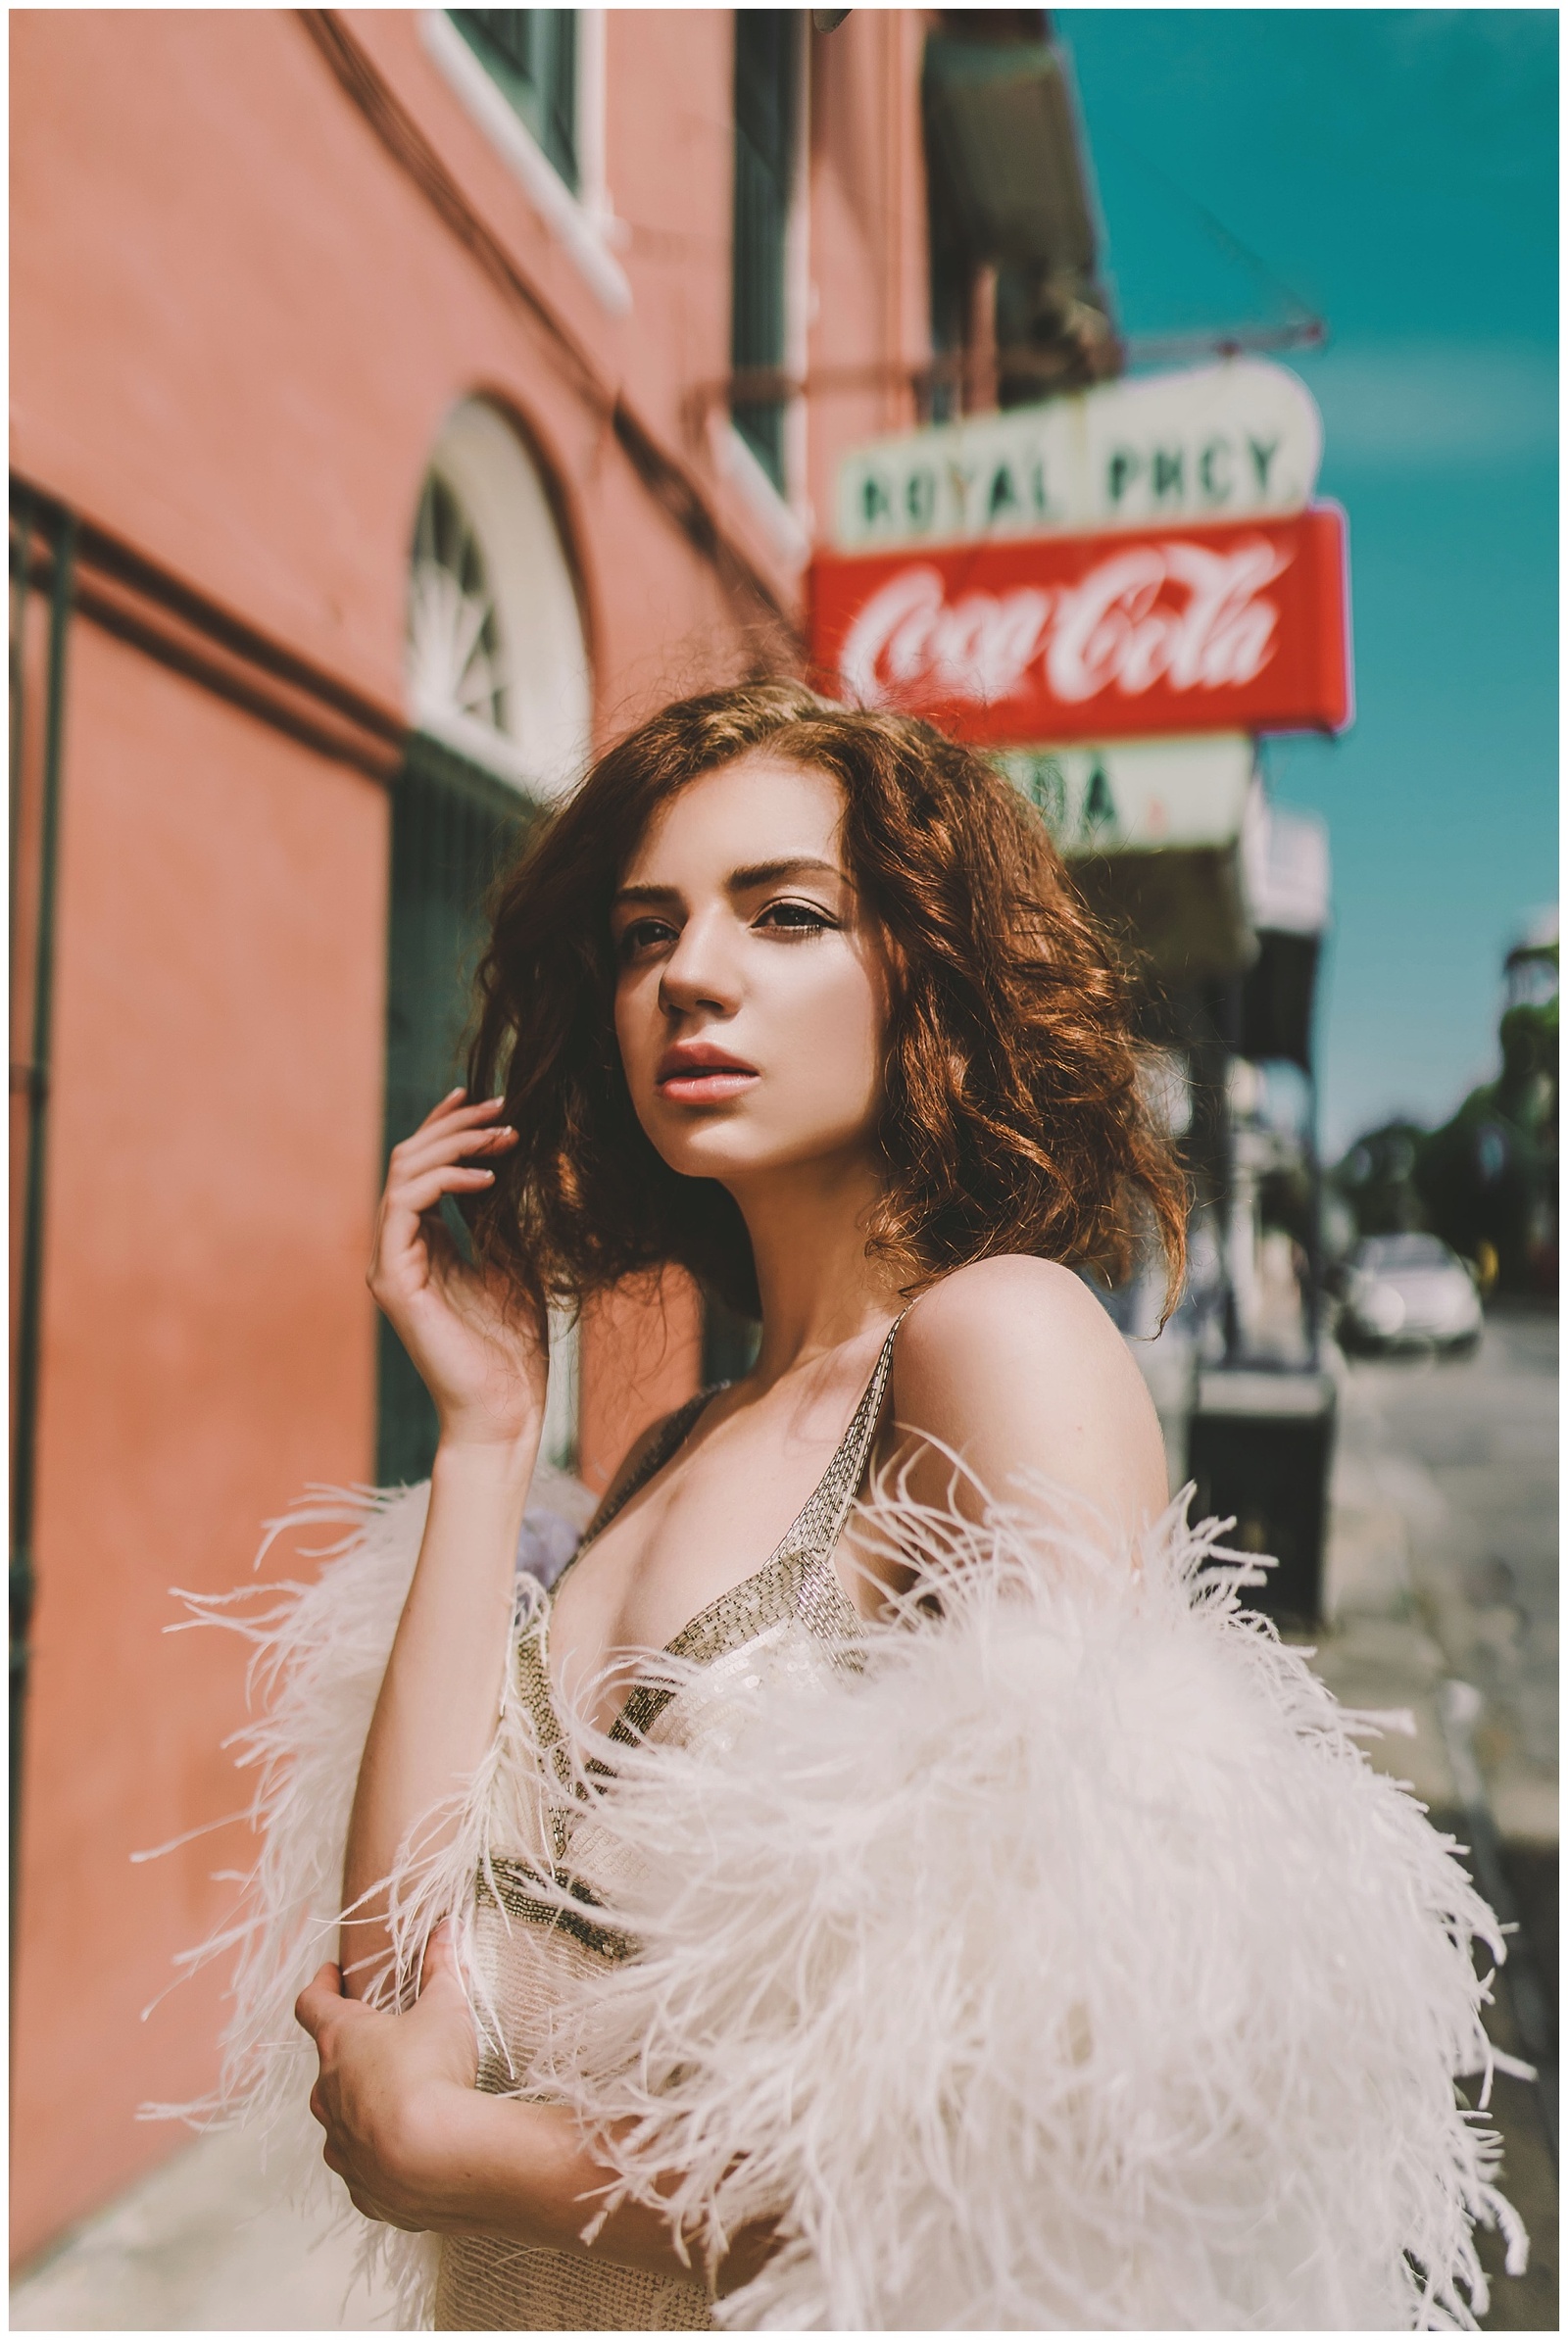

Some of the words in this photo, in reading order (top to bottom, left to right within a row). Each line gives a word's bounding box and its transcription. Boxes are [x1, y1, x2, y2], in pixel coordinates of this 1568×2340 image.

[858, 449, 1061, 526] ROYAL
[1106, 433, 1282, 507] PHCY
[1025, 755, 1122, 835] DA
